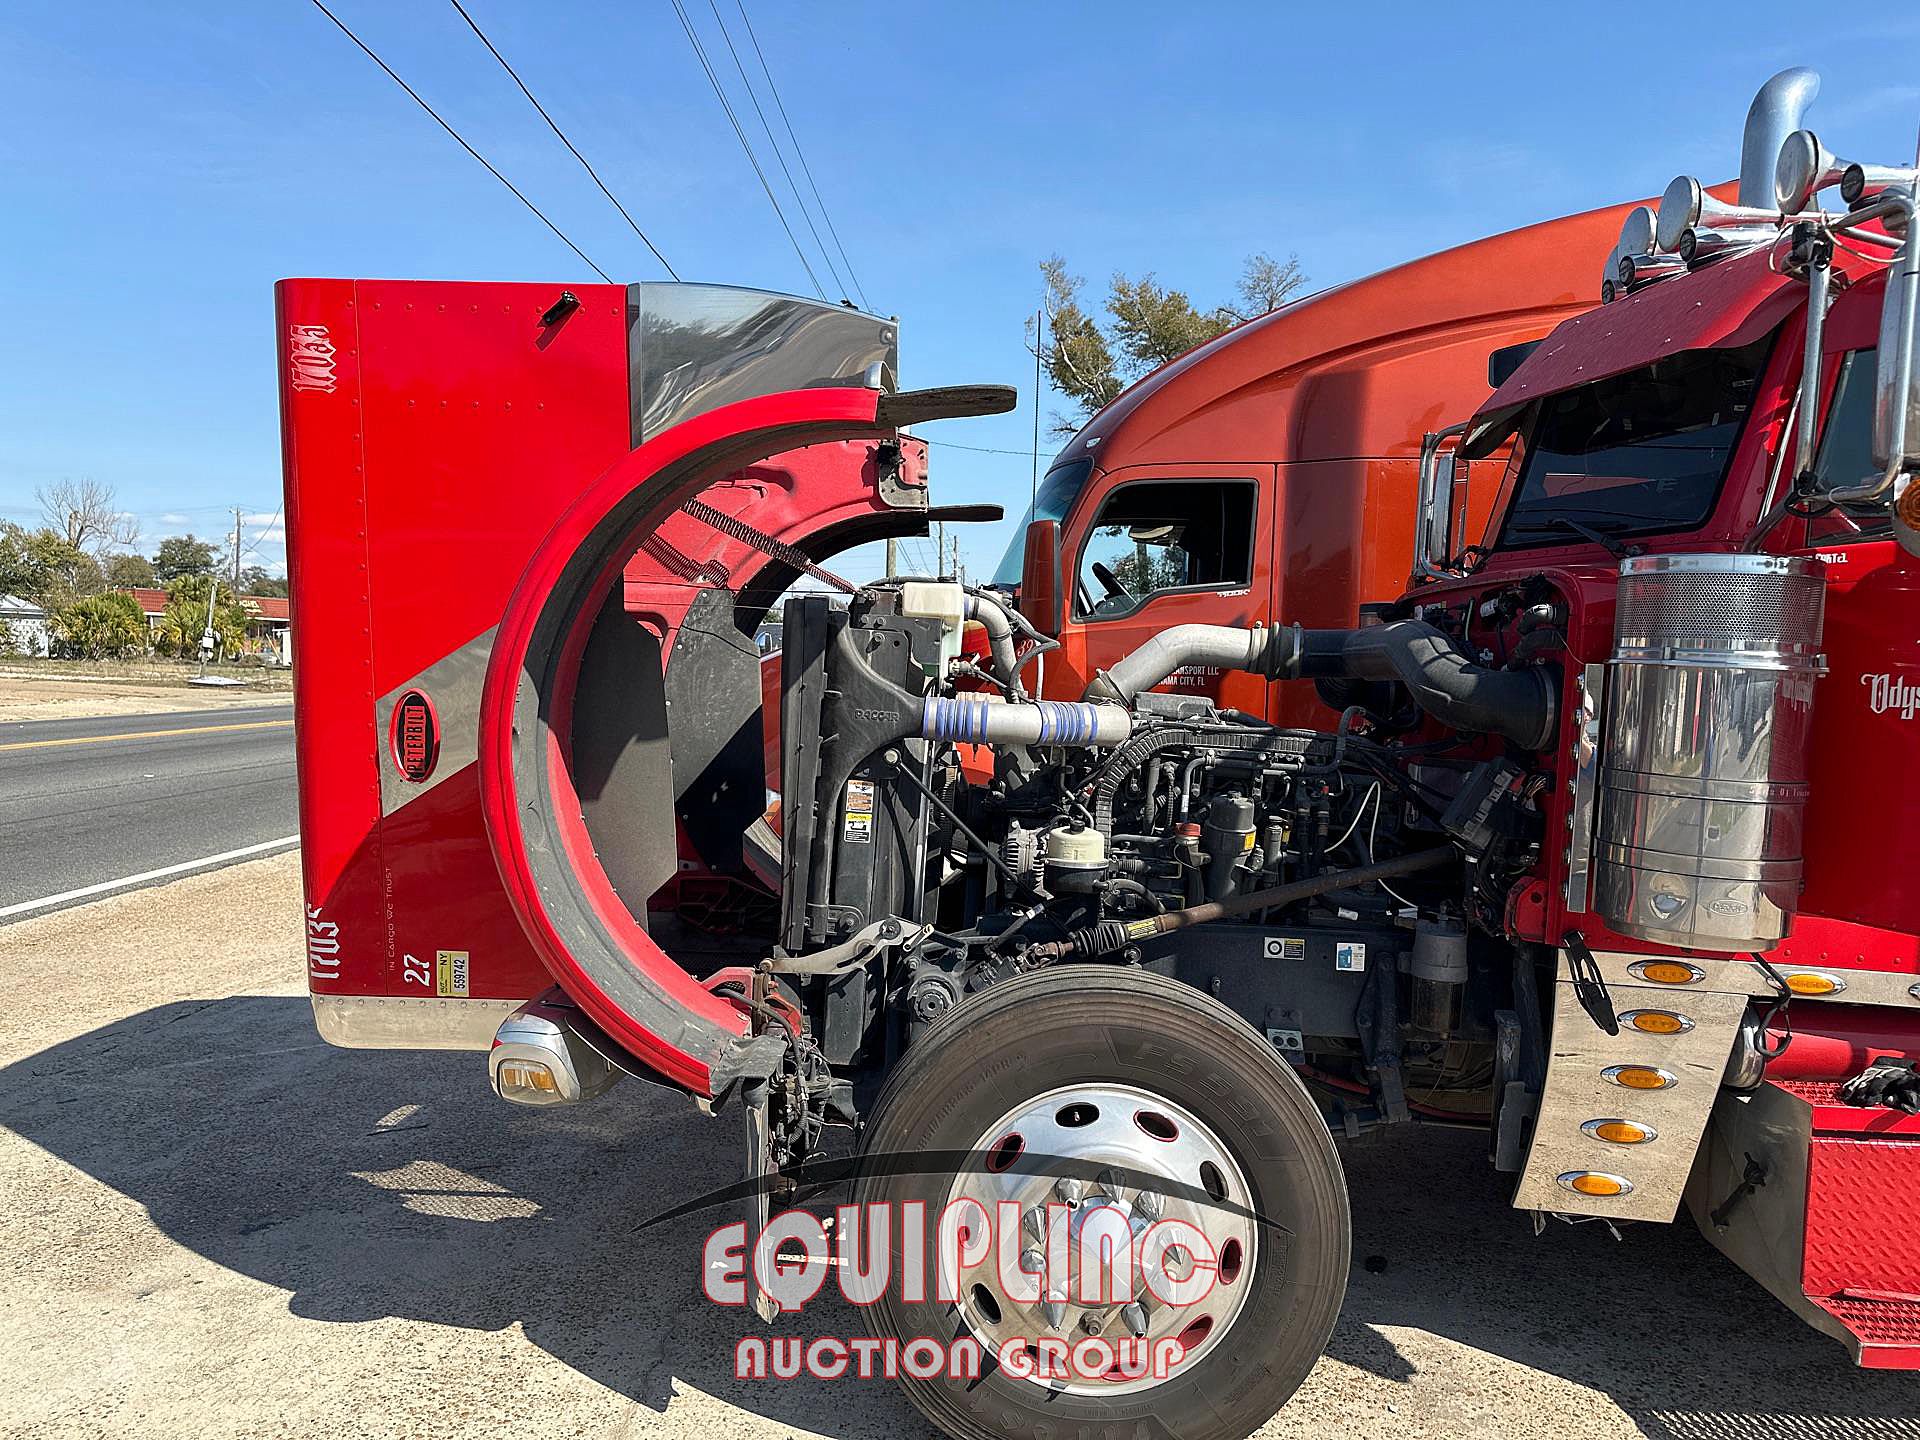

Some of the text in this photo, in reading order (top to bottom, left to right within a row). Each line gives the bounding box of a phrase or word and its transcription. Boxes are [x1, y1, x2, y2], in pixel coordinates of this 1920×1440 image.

[1207, 666, 1219, 676] LLC
[1197, 676, 1206, 686] FL
[854, 708, 900, 721] PACCAR
[406, 706, 425, 774] PETERBILT
[439, 953, 448, 966] NY
[403, 953, 431, 987] 27
[453, 959, 466, 989] 559742
